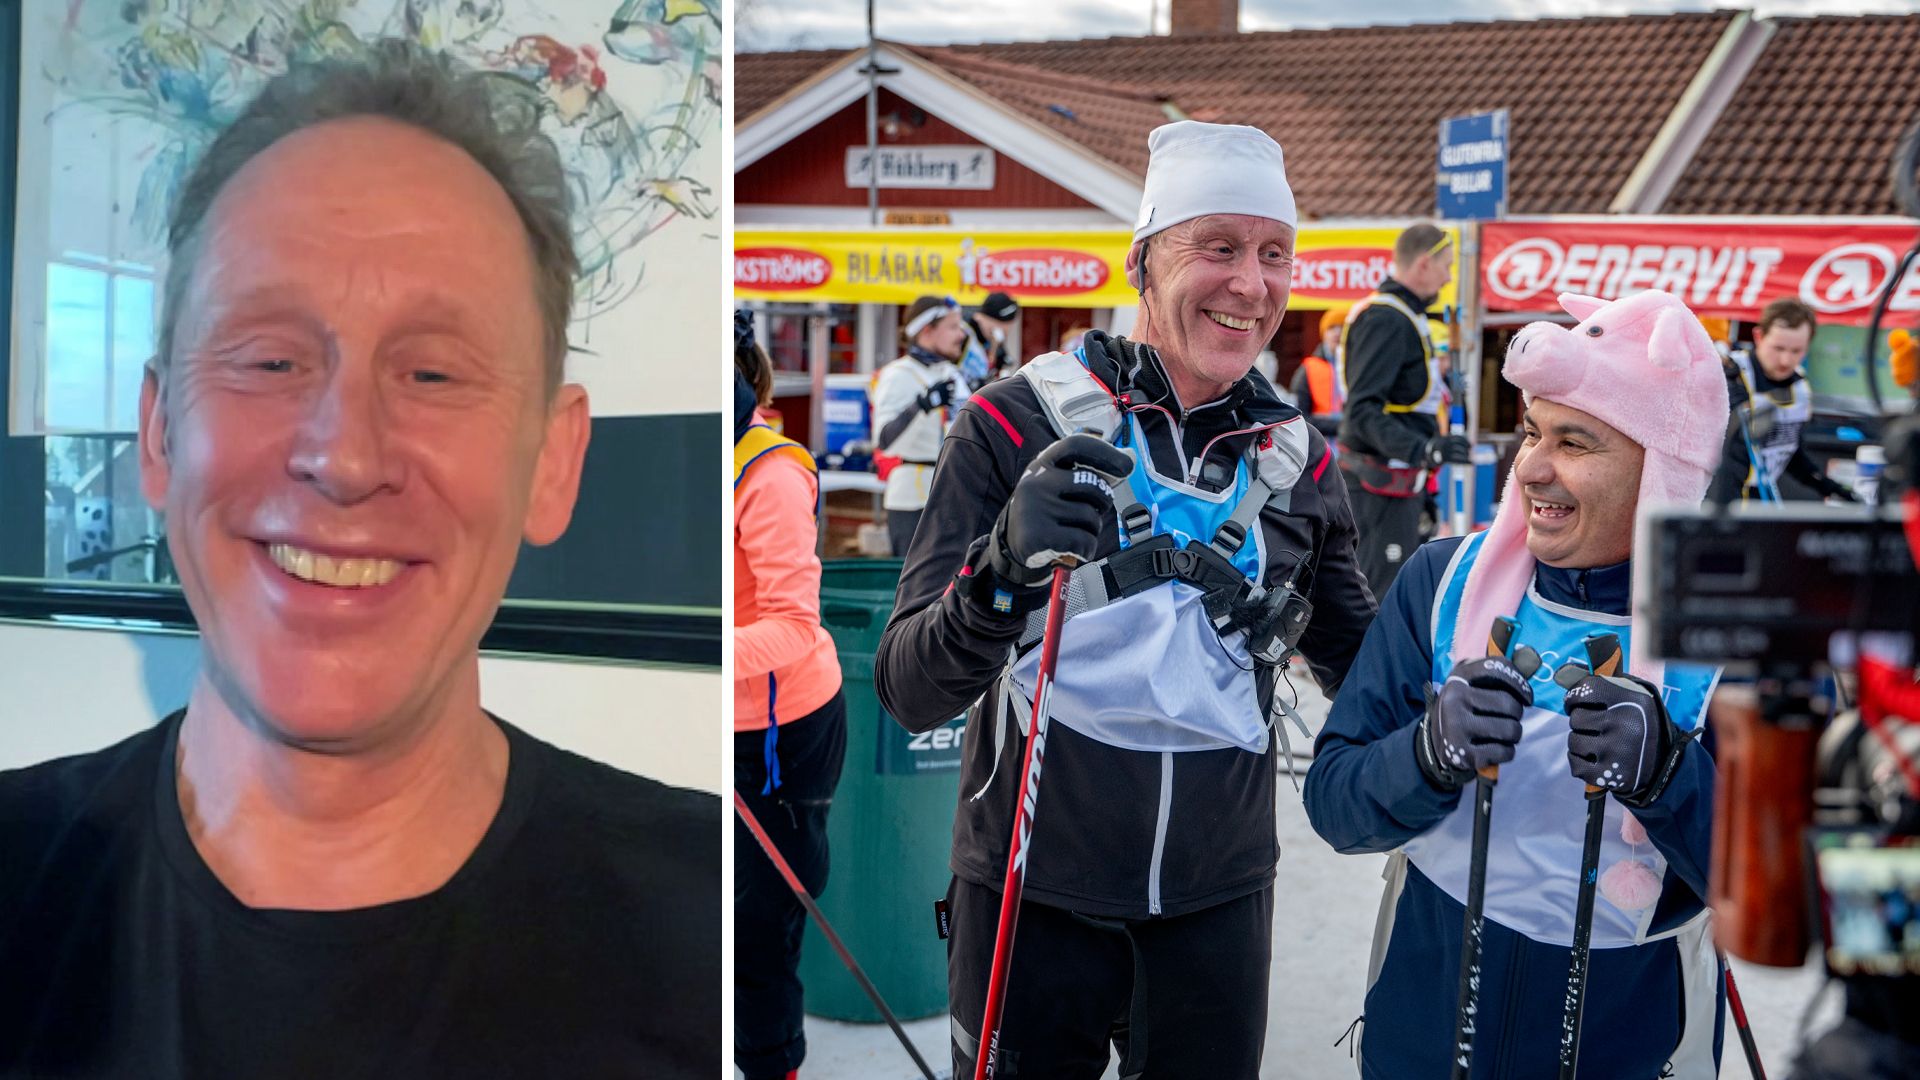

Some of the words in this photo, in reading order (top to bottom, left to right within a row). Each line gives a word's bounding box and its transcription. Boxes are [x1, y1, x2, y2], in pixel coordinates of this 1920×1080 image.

[847, 247, 944, 284] BLÅBÄR
[978, 256, 1100, 288] EKSTRÖMS
[1291, 256, 1397, 289] EKSTRÖ
[1553, 244, 1784, 307] ENERVIT
[1483, 659, 1524, 684] CRAFT
[1566, 686, 1582, 699] AFT
[985, 1030, 999, 1077] TRIAC
